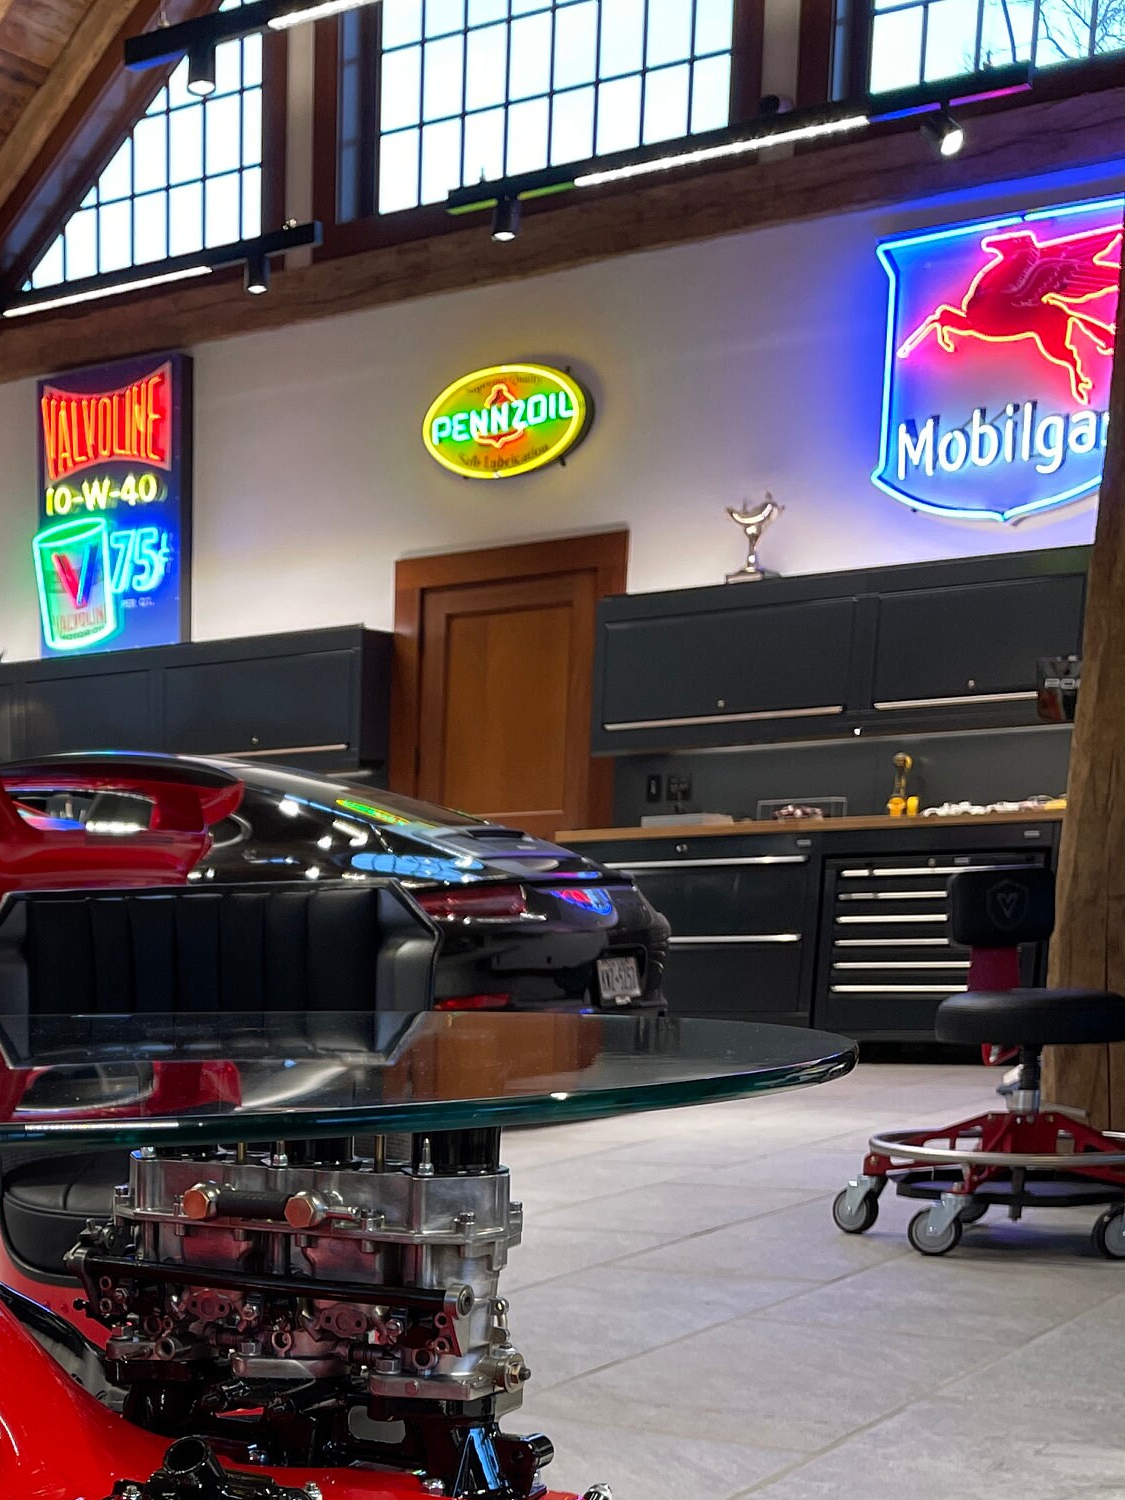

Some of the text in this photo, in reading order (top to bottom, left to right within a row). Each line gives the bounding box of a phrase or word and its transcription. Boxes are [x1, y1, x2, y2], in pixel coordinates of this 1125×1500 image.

[41, 373, 164, 480] VALVOLINE
[431, 391, 574, 446] PENNZOIL
[897, 402, 1109, 480] Mobilga
[46, 474, 158, 516] 10-W-40
